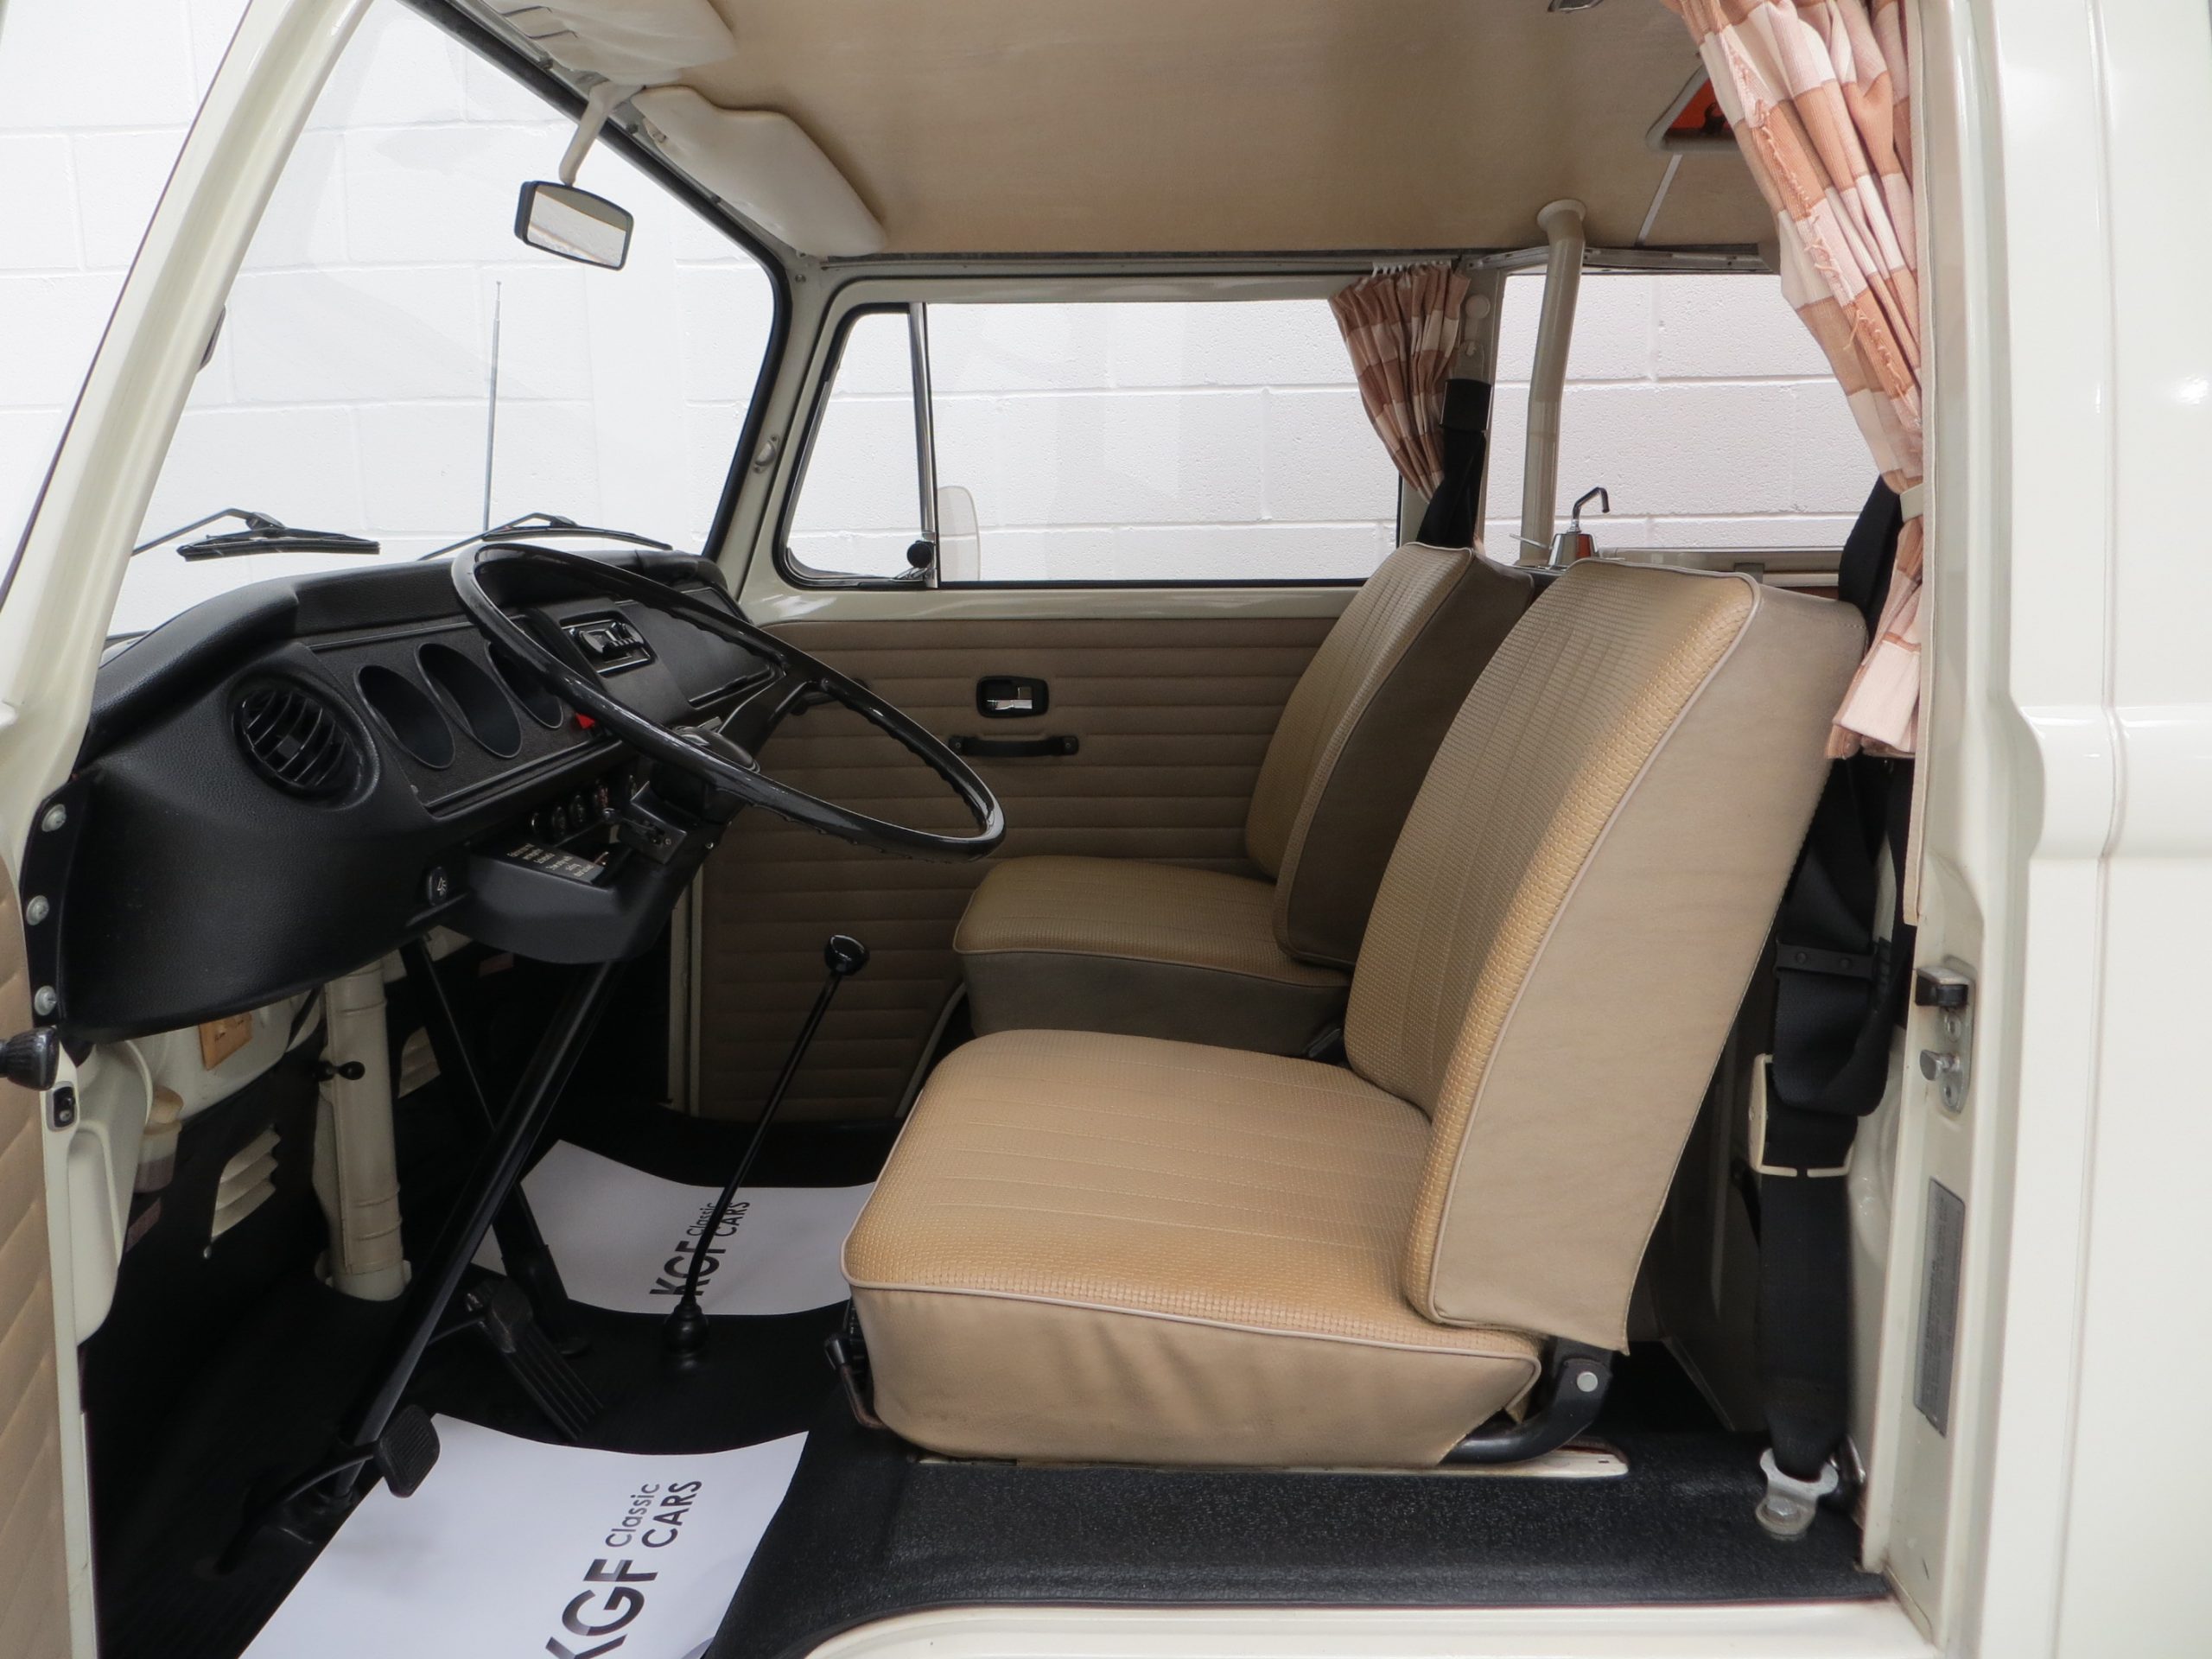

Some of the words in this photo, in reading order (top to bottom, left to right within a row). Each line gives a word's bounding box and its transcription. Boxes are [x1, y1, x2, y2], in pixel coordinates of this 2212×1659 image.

[686, 1202, 716, 1236] Classic
[714, 1201, 751, 1237] CARS
[605, 1483, 660, 1548] Classic
[641, 1480, 702, 1548] CARS
